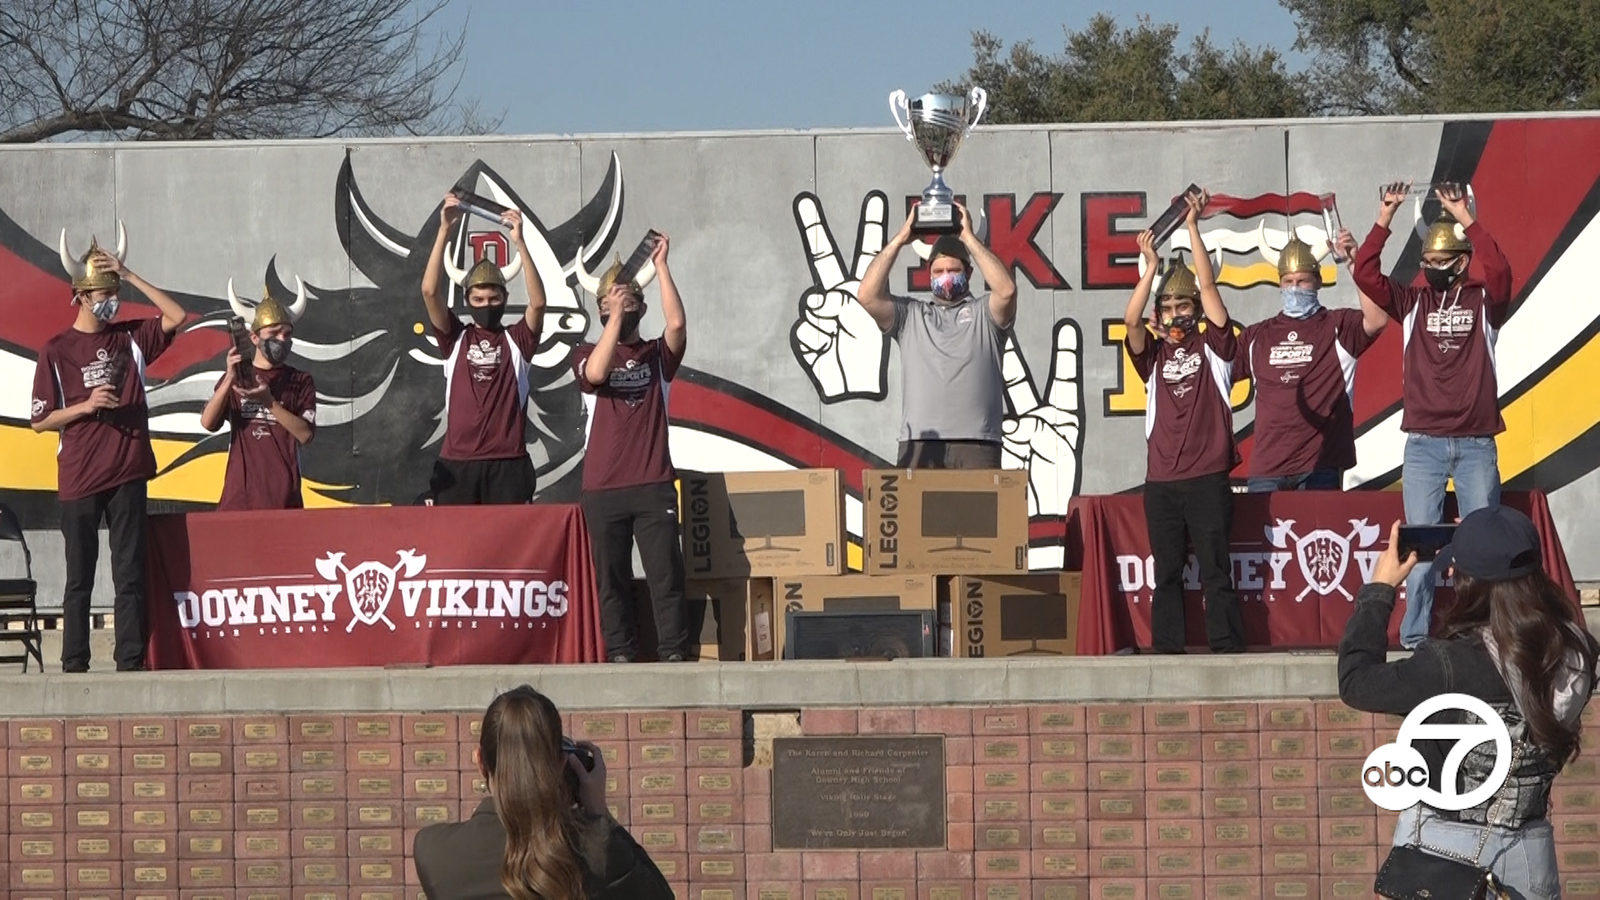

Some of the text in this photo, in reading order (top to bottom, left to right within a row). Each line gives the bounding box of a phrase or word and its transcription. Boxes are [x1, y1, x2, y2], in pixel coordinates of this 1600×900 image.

[690, 480, 711, 573] LEGION
[880, 475, 899, 569] LEGION
[173, 579, 569, 629] DOWNEY VIKINGS
[967, 582, 985, 658] EGION
[852, 749, 884, 757] Richard
[887, 750, 929, 759] Carpenter
[811, 767, 841, 775] Alumni
[863, 767, 894, 775] Friends
[816, 776, 901, 785] Downey High School
[836, 829, 855, 838] Only
[858, 829, 877, 837] Just
